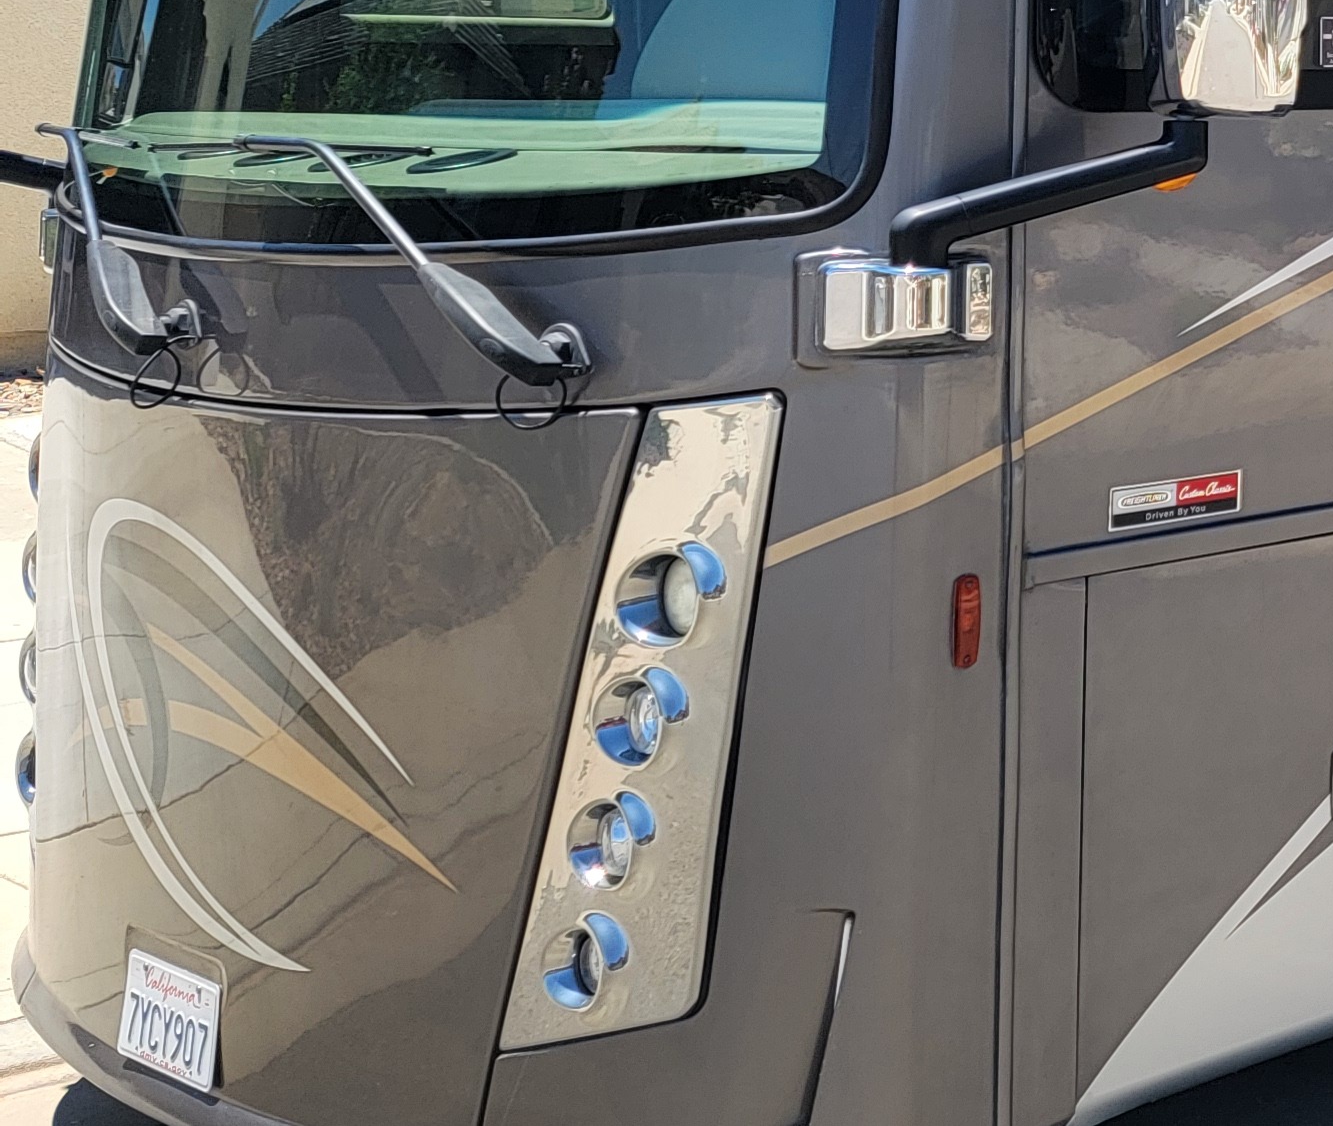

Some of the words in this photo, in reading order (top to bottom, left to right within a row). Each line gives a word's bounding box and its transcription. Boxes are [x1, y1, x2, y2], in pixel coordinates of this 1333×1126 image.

[1145, 508, 1174, 520] Driven
[1177, 507, 1189, 517] By
[1190, 505, 1207, 514] You
[144, 965, 198, 1006] California
[128, 991, 209, 1076] 7YCY907
